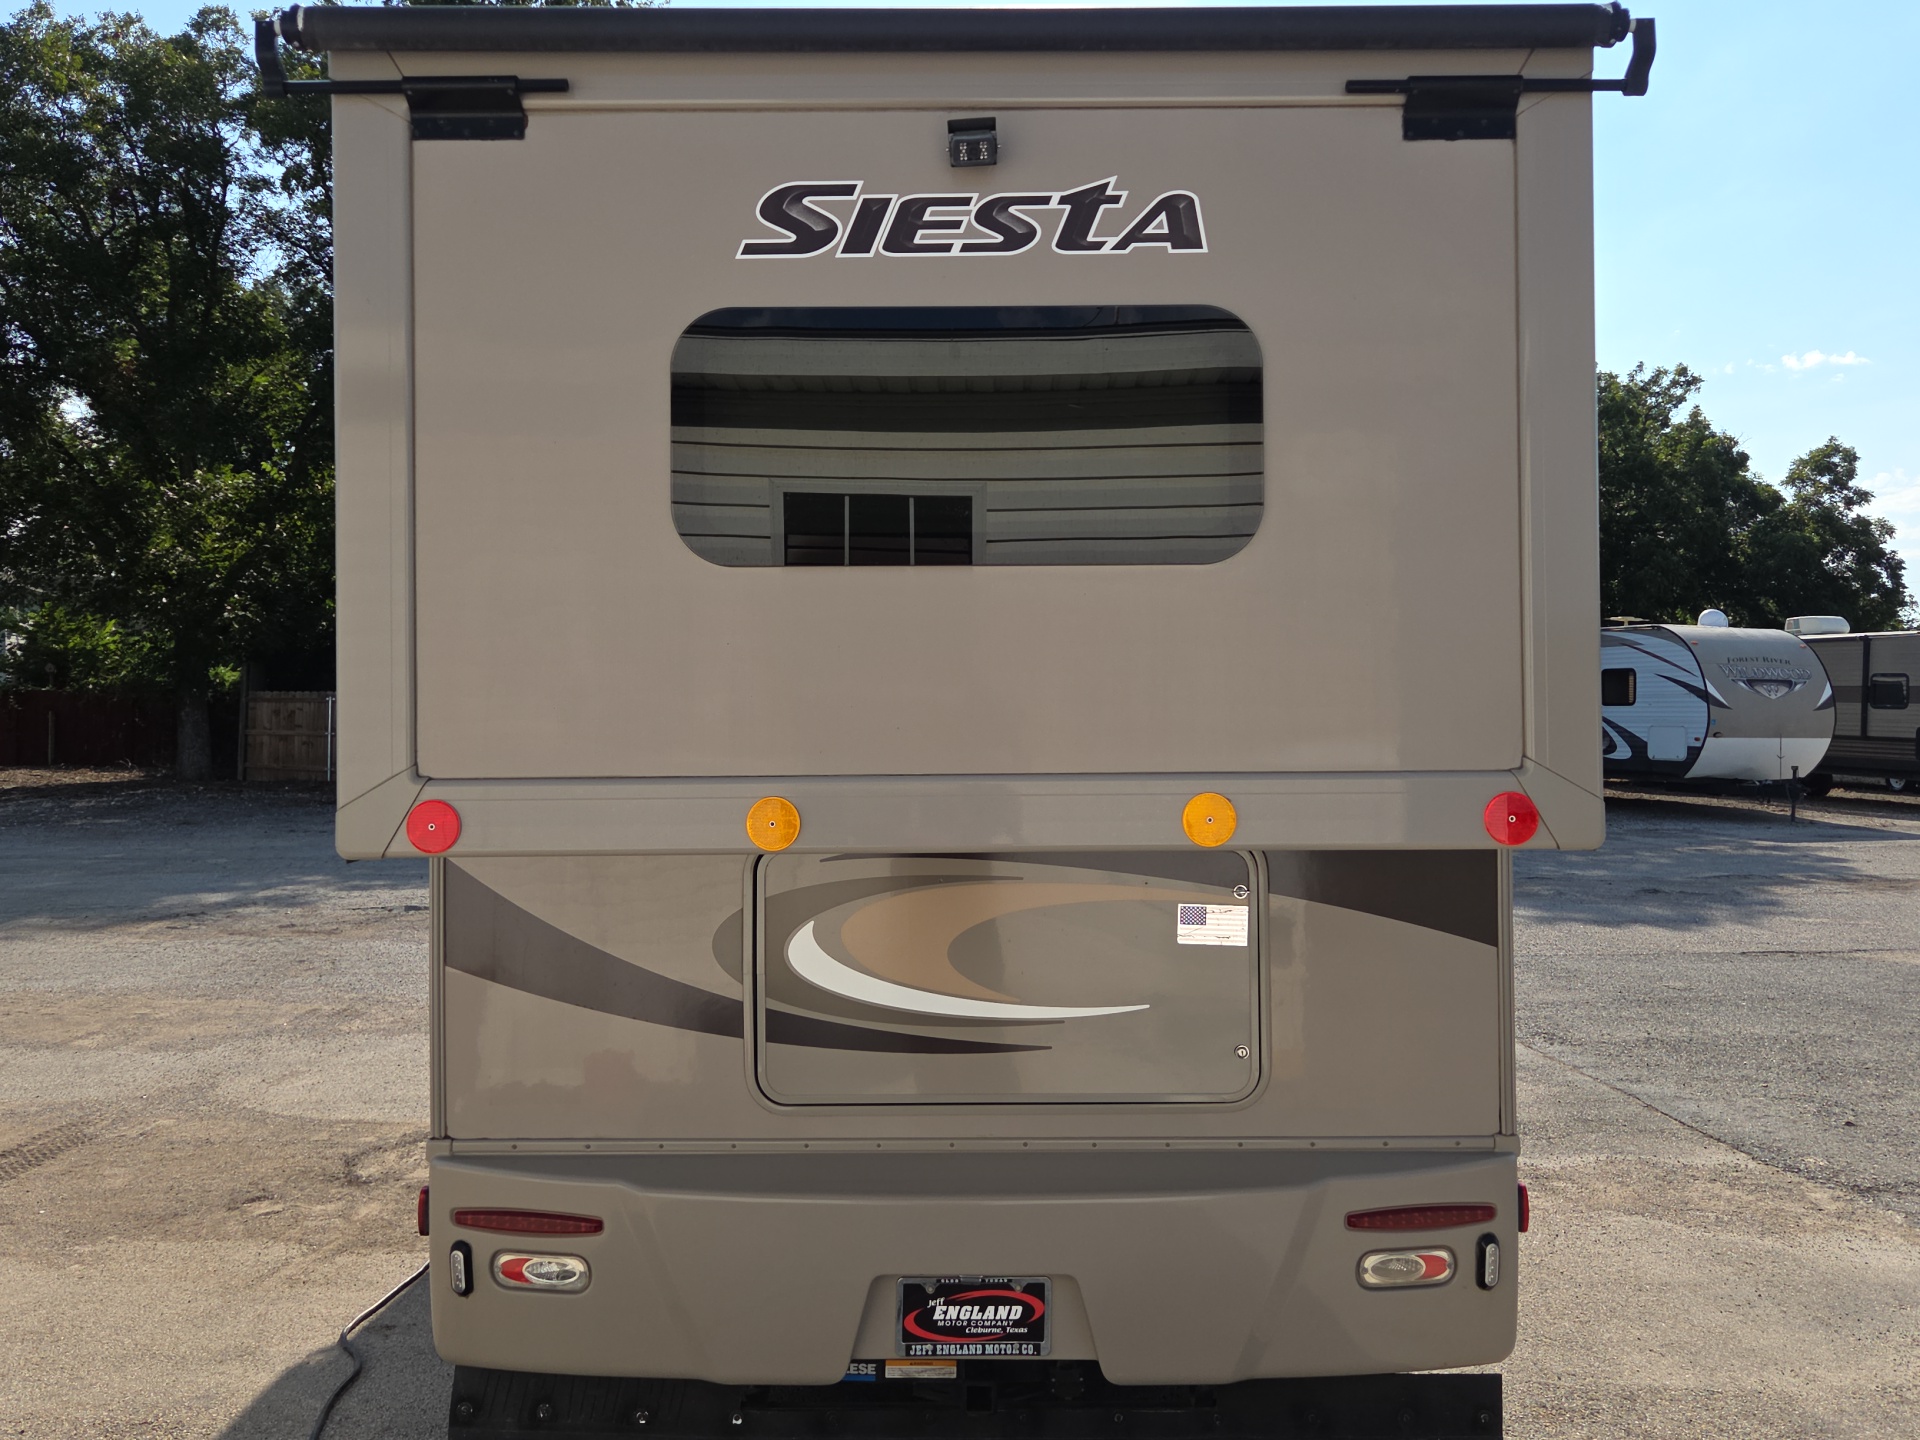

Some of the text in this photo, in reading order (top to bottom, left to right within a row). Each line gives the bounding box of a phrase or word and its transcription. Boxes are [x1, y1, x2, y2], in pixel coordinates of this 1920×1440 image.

[1763, 656, 1791, 665] RIVER
[1718, 664, 1812, 680] WILDWOOD
[932, 1305, 1023, 1320] ENGLAND
[965, 1326, 1004, 1334] Cleburne,
[909, 1343, 1037, 1355] JEFF ENGLAND MOTOR CO.
[846, 1363, 877, 1375] ESE
